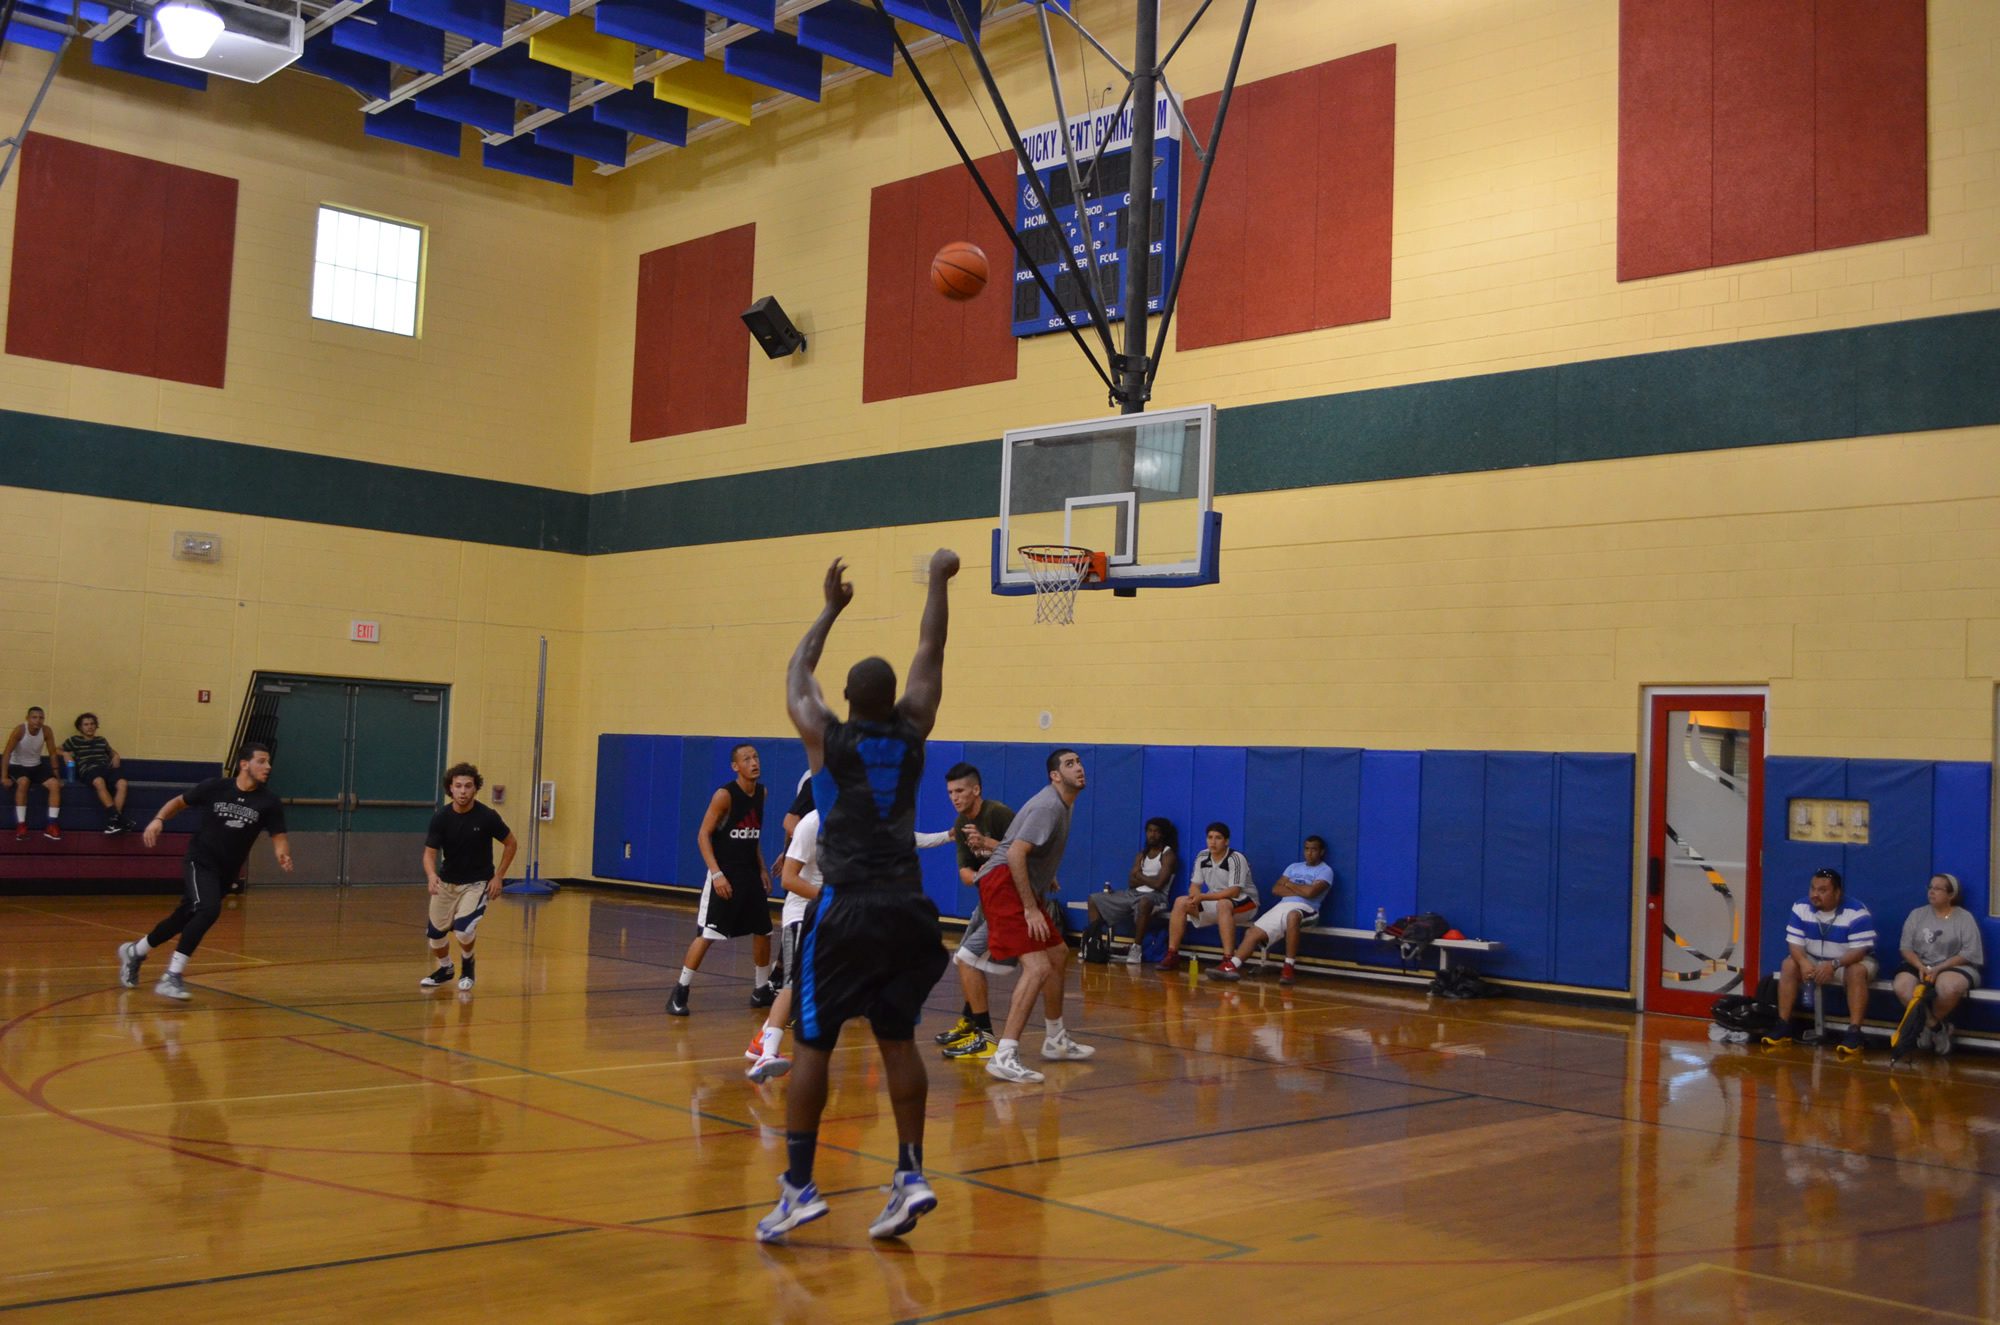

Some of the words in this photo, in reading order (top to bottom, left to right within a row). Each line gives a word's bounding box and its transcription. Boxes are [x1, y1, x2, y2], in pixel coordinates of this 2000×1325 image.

[1061, 120, 1091, 155] ENT
[1074, 205, 1102, 219] PRIOD
[1024, 213, 1049, 229] HOM
[1059, 258, 1088, 273] PLER
[1100, 252, 1120, 264] FOUL
[1017, 270, 1034, 281] FOUL
[356, 623, 375, 639] EXIT
[729, 827, 760, 839] adida
